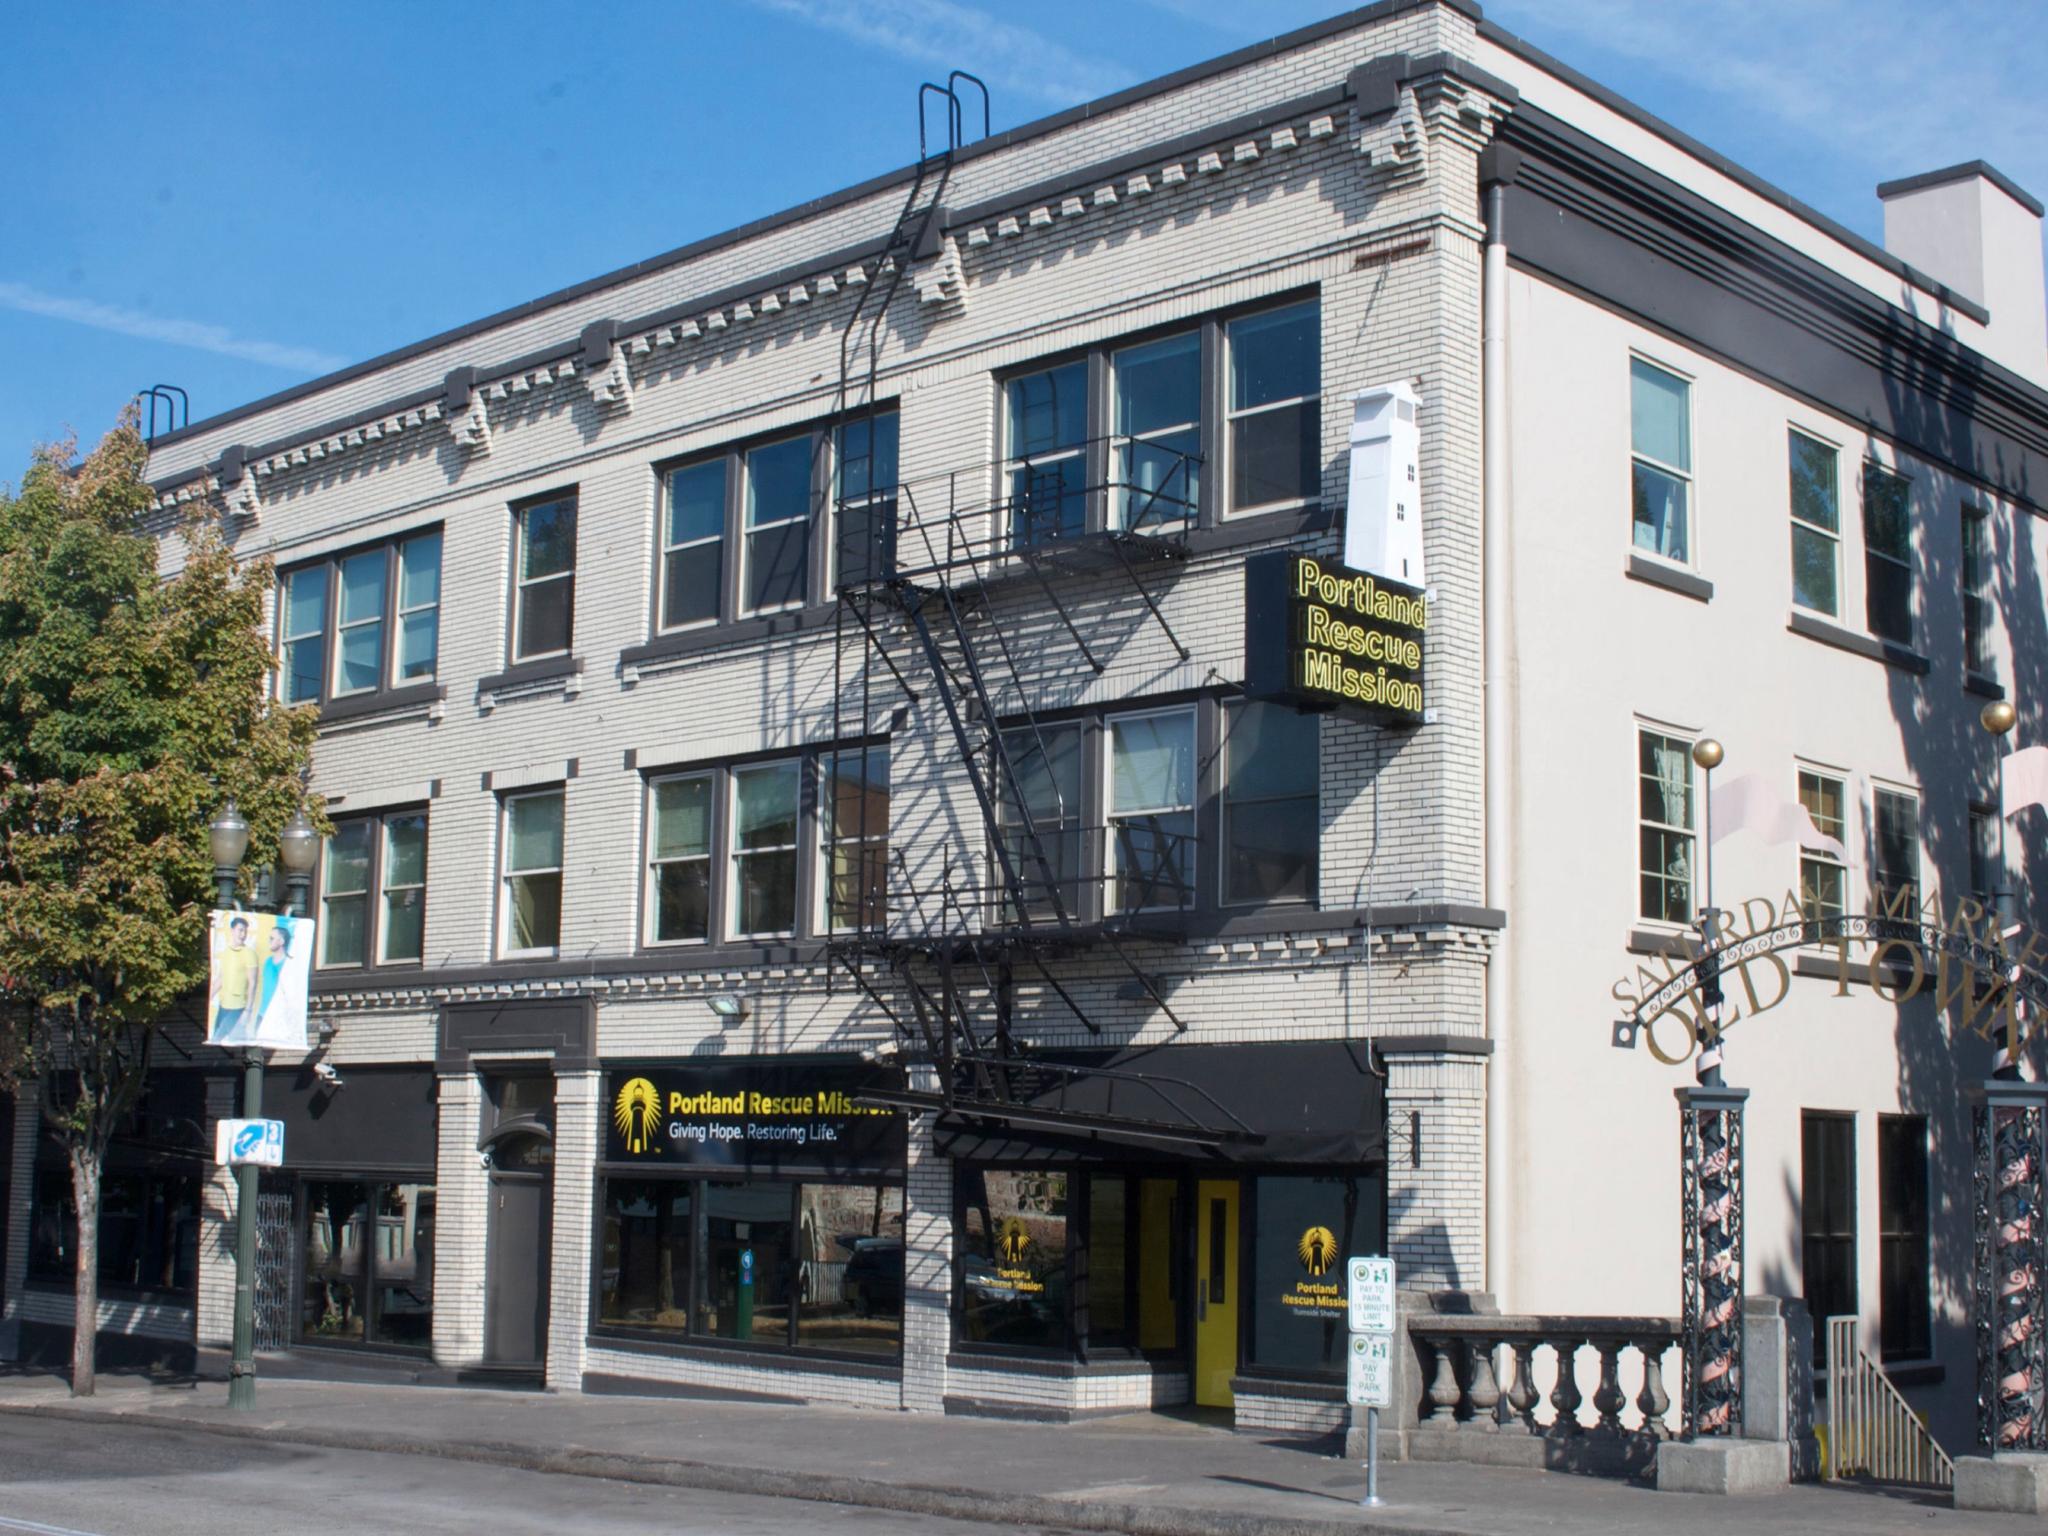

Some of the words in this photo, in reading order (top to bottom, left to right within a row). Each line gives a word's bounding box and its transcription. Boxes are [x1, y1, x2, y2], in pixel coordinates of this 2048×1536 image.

[1299, 558, 1428, 629] Portland
[1308, 604, 1421, 669] Rescue
[1305, 648, 1422, 712] Mission
[1646, 951, 1790, 1065] OLD
[669, 1090, 745, 1115] Portland
[749, 1091, 814, 1115] Rescue
[818, 1091, 894, 1116] Miss
[668, 1122, 706, 1143] Giving
[709, 1122, 744, 1143] Hope.
[747, 1123, 806, 1144] Restoring
[1296, 1282, 1338, 1295] Portland
[1360, 1285, 1373, 1293] PAY
[1375, 1285, 1385, 1293] TO
[1282, 1294, 1315, 1306] Rescue
[1362, 1294, 1382, 1302] PARK
[1363, 1303, 1391, 1313] MINUTE
[1363, 1312, 1381, 1321] LIMIT
[1362, 1363, 1378, 1373] PAY
[1364, 1373, 1376, 1382] TO
[1358, 1382, 1380, 1392] PARK
